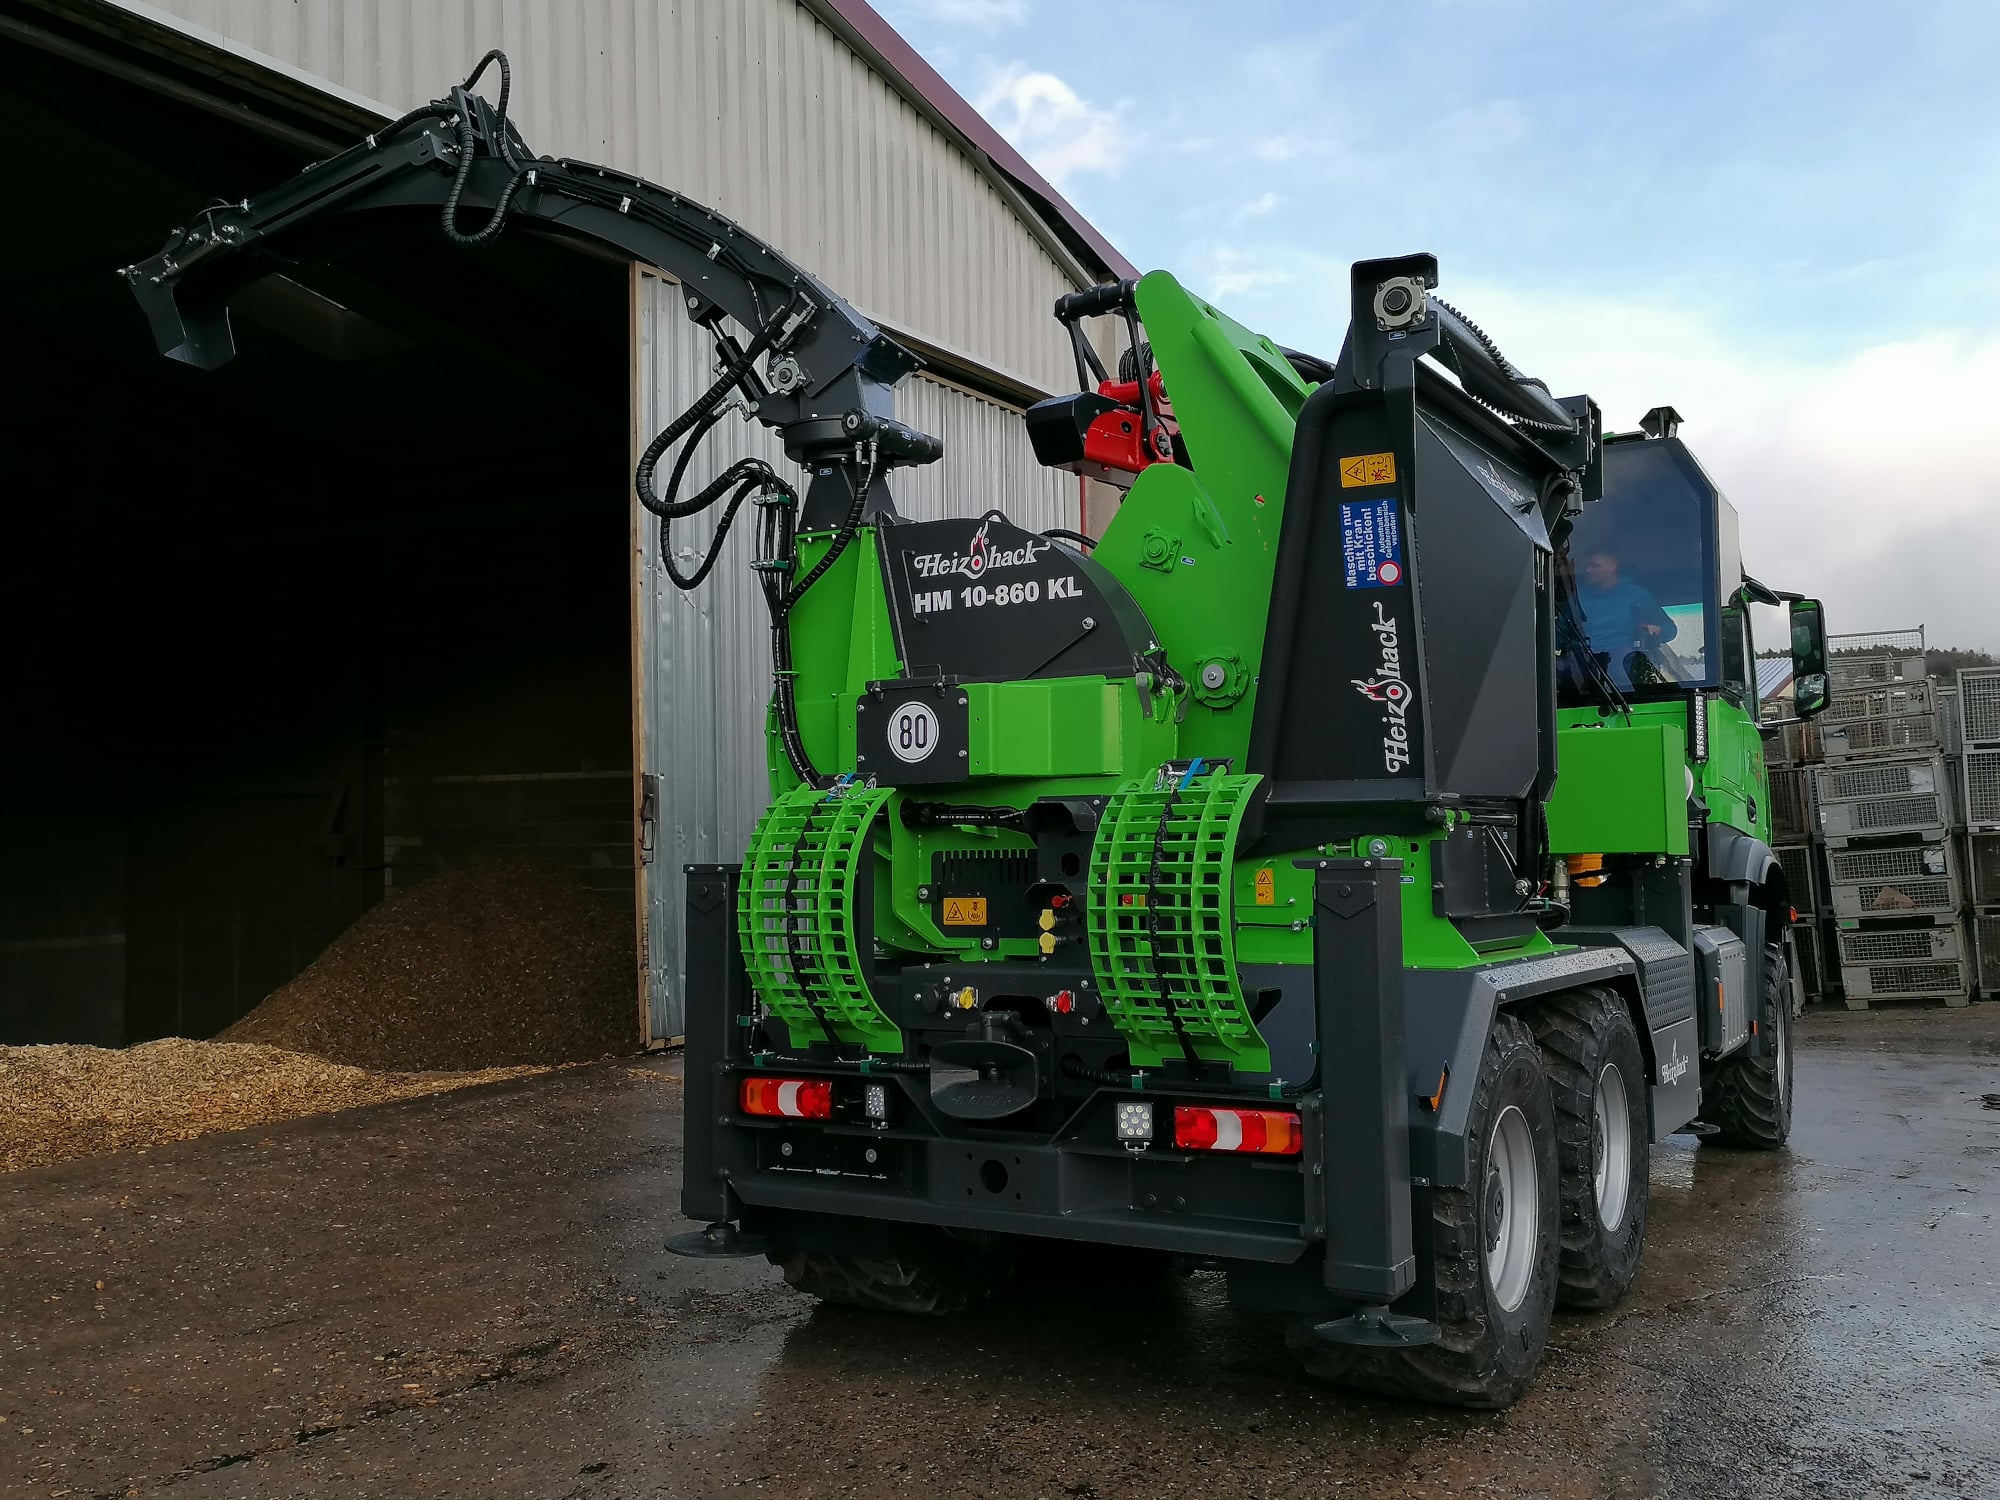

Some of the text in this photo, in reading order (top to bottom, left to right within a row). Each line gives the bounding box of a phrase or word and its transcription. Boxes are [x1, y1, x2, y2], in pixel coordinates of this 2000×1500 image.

[1342, 504, 1357, 587] Maschine nur
[1353, 519, 1366, 571] mit Kran
[1361, 507, 1377, 581] beschicken!
[914, 576, 1083, 614] HM 10-860 KL
[899, 714, 928, 750] 80
